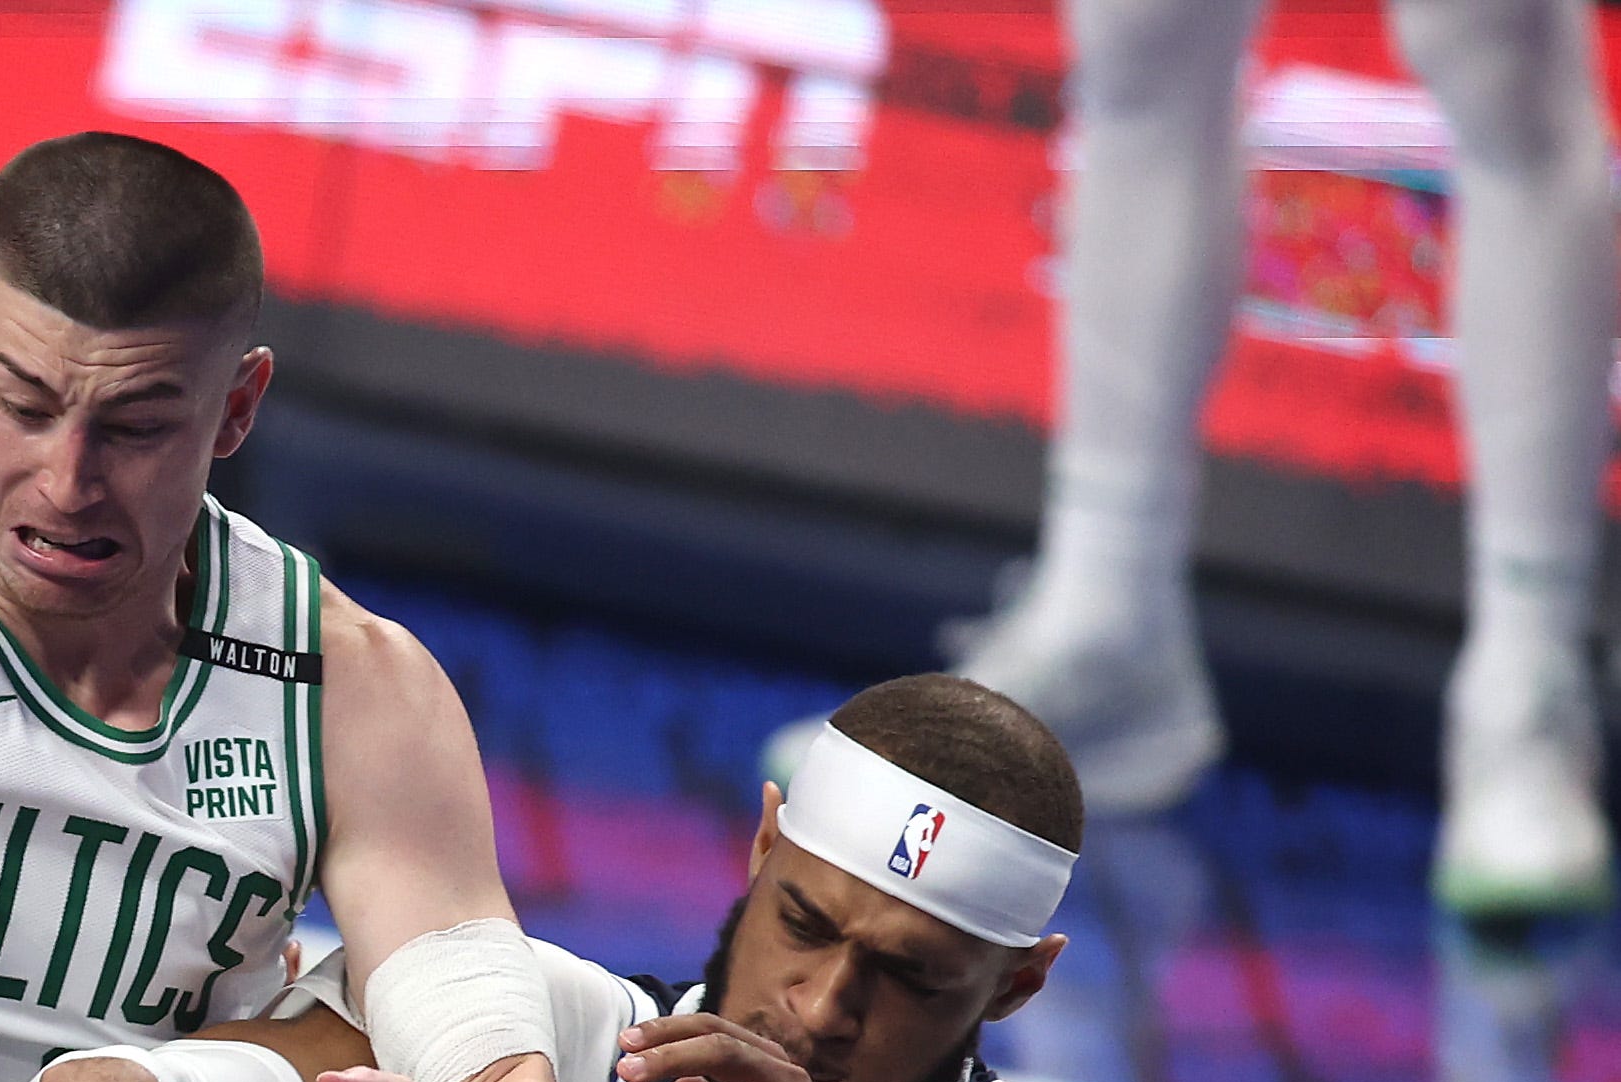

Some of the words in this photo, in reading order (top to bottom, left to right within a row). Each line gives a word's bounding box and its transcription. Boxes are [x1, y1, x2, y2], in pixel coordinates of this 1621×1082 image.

[209, 636, 296, 678] WALTON
[184, 737, 276, 784] VISTA
[186, 784, 277, 818] PRINT
